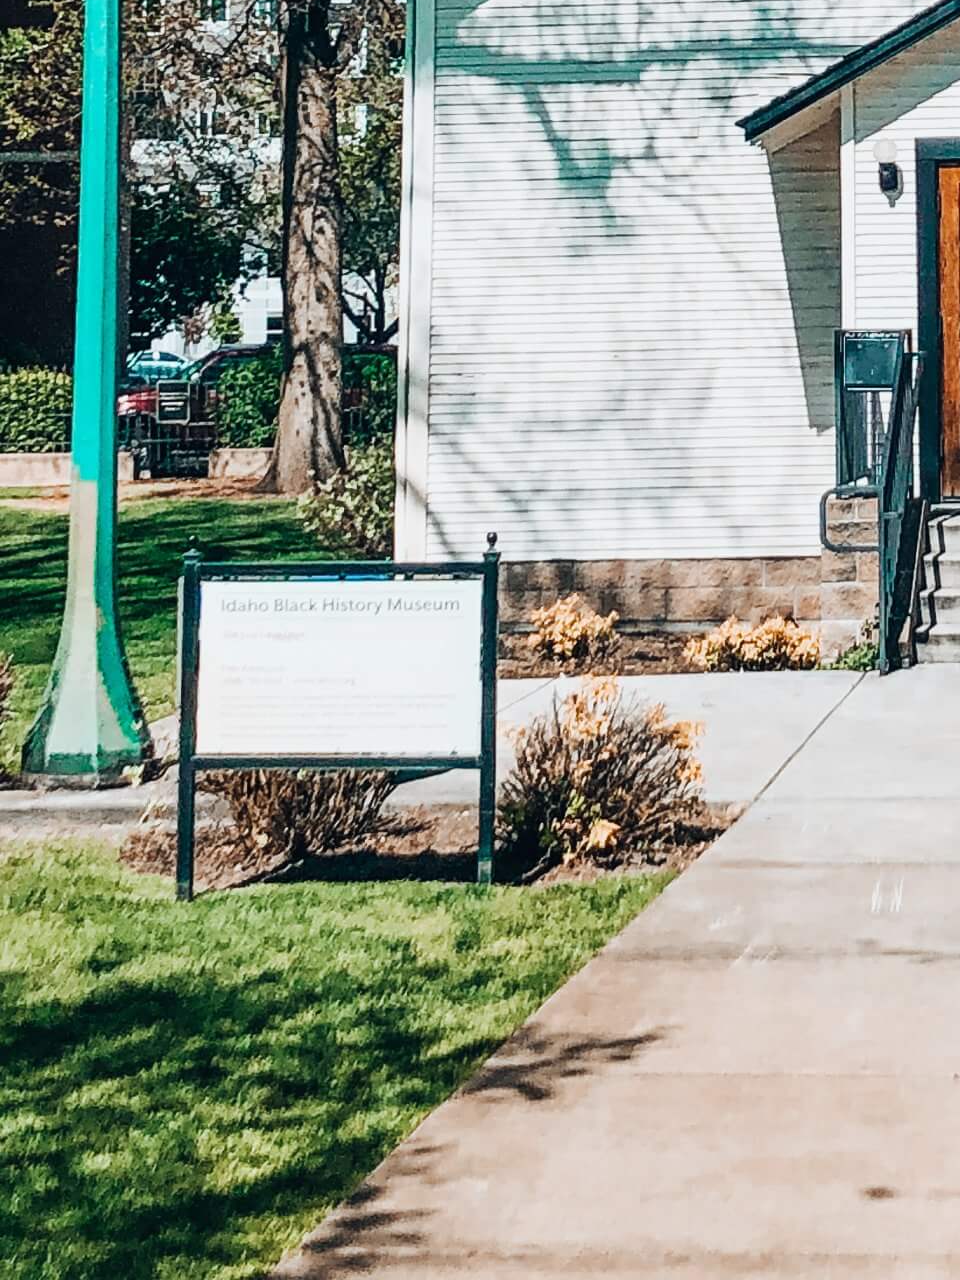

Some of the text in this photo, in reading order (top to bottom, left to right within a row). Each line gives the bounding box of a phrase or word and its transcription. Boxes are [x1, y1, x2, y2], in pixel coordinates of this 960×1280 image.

[221, 597, 461, 616] Idaho Black History Museum
